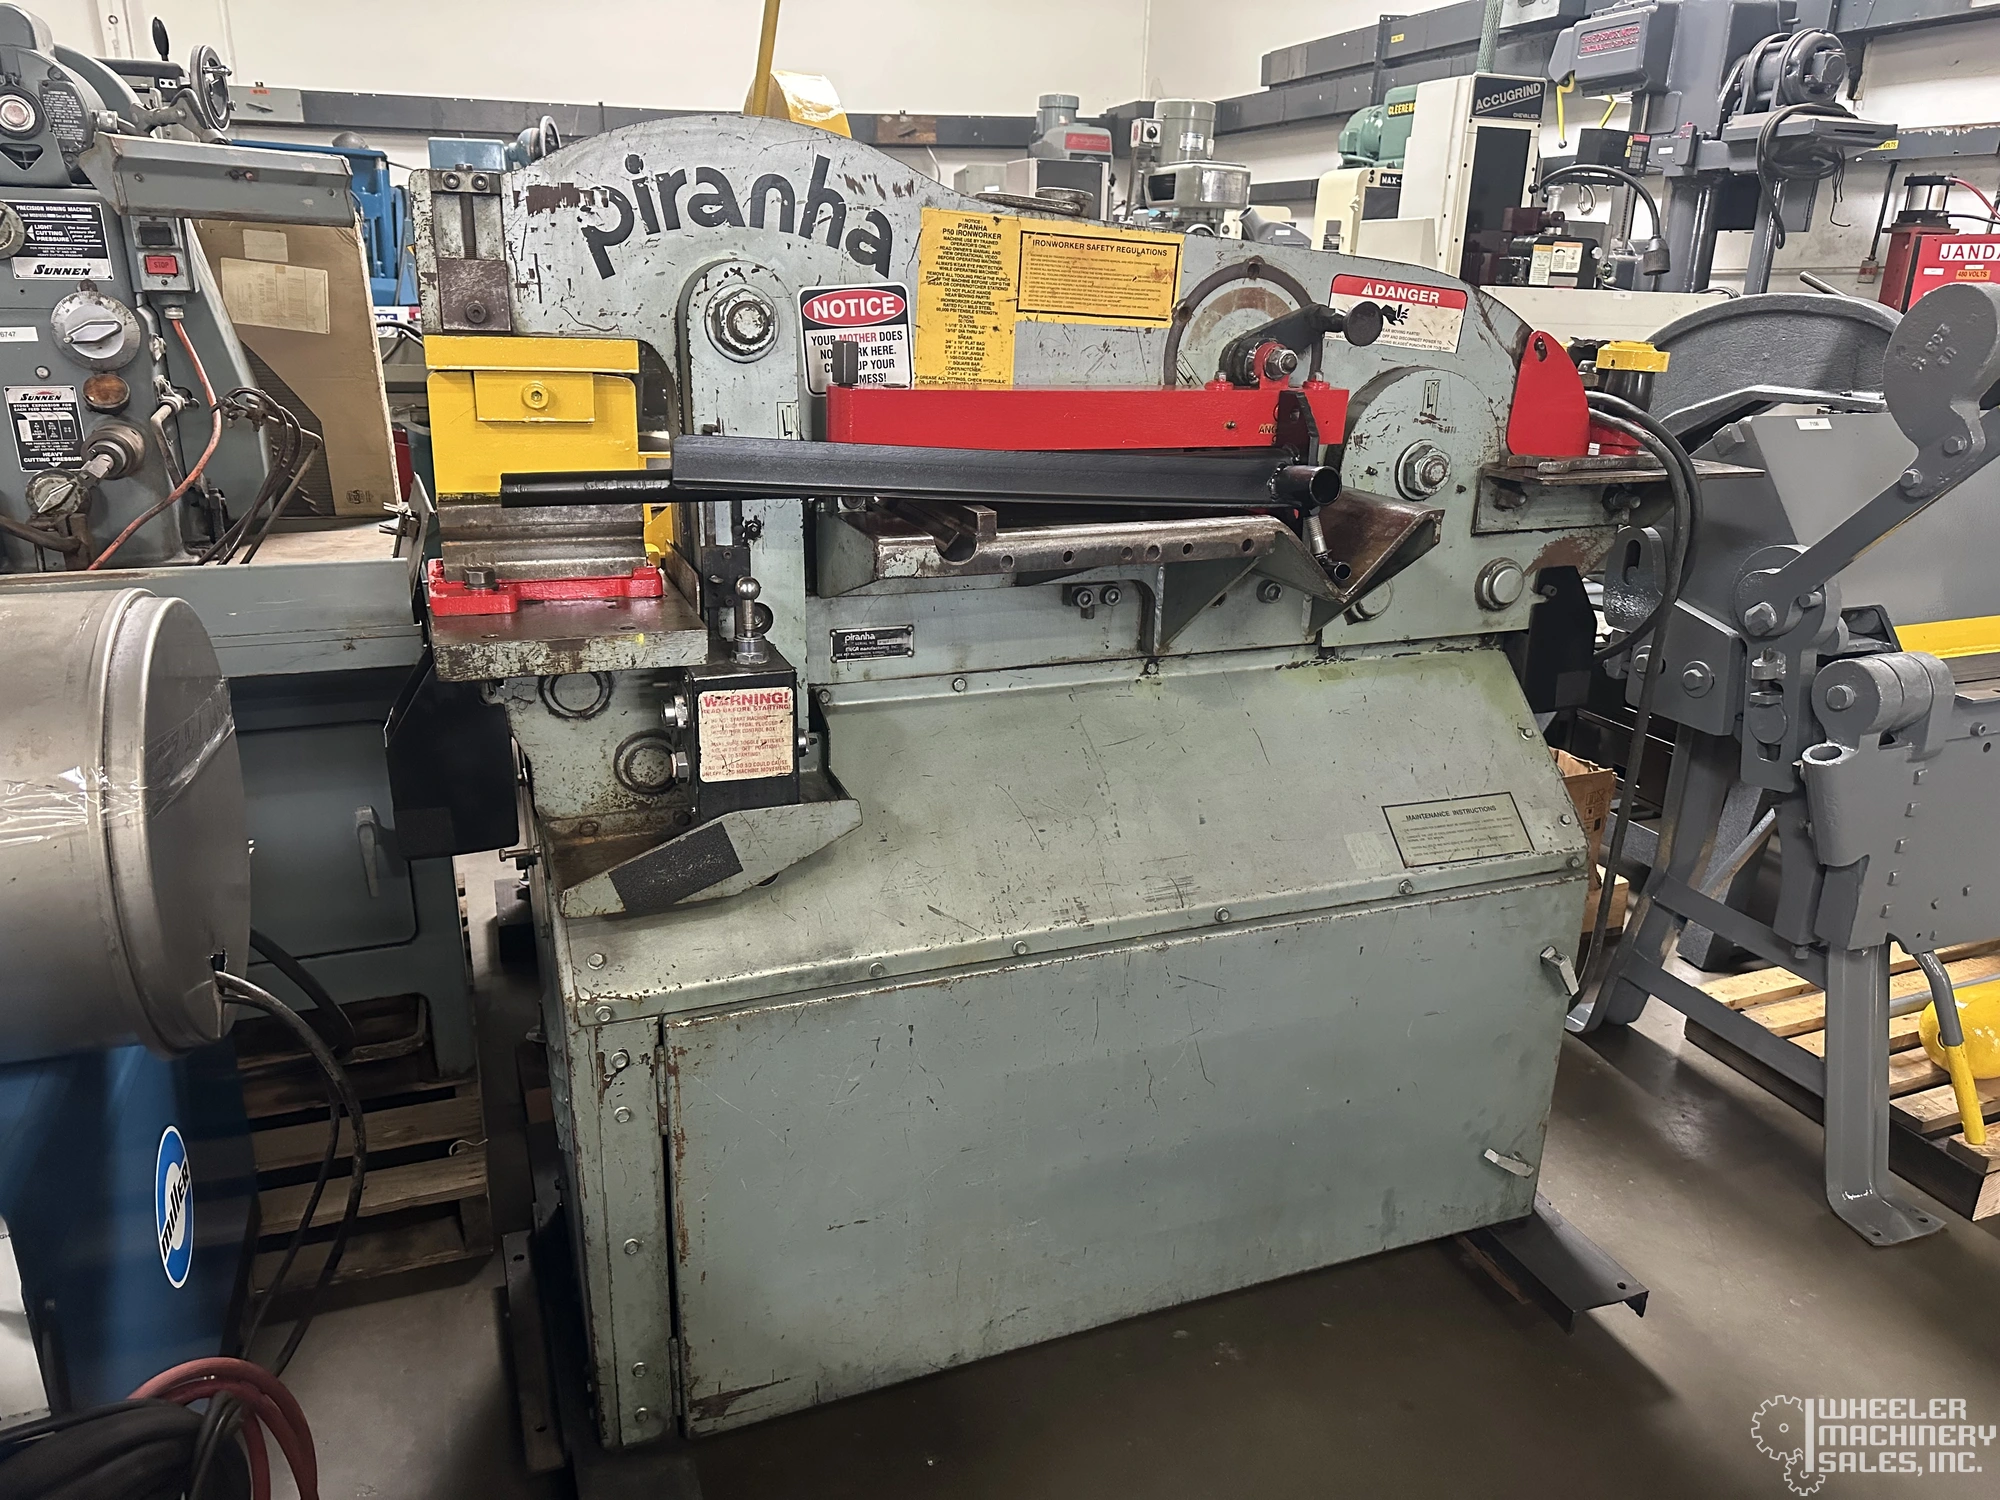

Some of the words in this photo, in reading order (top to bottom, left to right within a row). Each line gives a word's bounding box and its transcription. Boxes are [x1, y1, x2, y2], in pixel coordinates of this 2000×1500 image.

[1475, 83, 1541, 111] ACCUGRIND
[1388, 103, 1416, 115] CLEEREM
[1382, 176, 1401, 184] MAX-
[577, 154, 894, 279] piranha
[958, 223, 987, 231] PIRANHA
[956, 230, 1001, 239] IRONWORKER
[1033, 239, 1084, 250] IRONWORKER
[1086, 244, 1114, 252] SAFETY
[1116, 246, 1167, 256] REGULATIONS
[34, 265, 92, 276] SUNNEN
[1375, 284, 1440, 304] DANGER
[813, 297, 896, 319] NOTICE
[811, 335, 836, 346] YOUR
[839, 332, 877, 343] MOTHER
[879, 331, 902, 341] DOES
[820, 350, 833, 359] NO
[871, 345, 896, 356] HERE.
[871, 359, 895, 370] YOUR
[859, 373, 886, 383] MESS!
[1259, 424, 1276, 434] ANG
[845, 632, 875, 644] piranha
[703, 692, 789, 707] WARNING!
[1406, 810, 1450, 821] MAINTENANCE
[1452, 805, 1497, 816] INSTRUCTIONS
